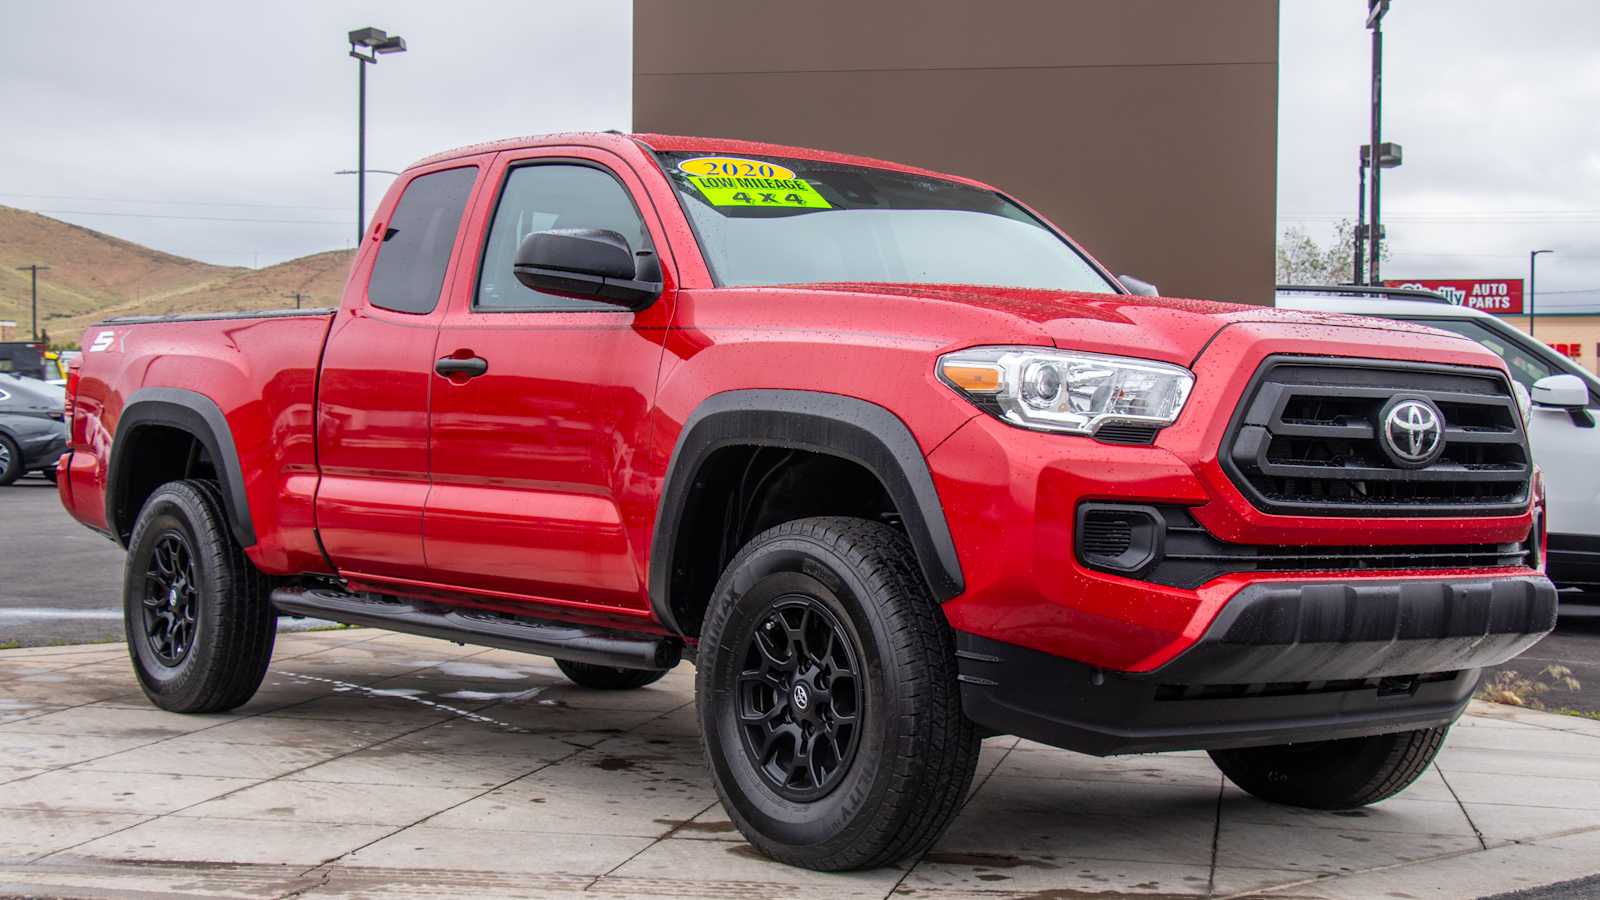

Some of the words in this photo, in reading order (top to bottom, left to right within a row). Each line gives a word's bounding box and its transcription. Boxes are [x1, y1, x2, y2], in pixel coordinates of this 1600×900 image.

[704, 162, 774, 177] 2020
[700, 177, 737, 189] LOW
[736, 178, 808, 191] MILEAGE
[1472, 283, 1508, 296] AUTO
[1468, 296, 1511, 309] PARTS
